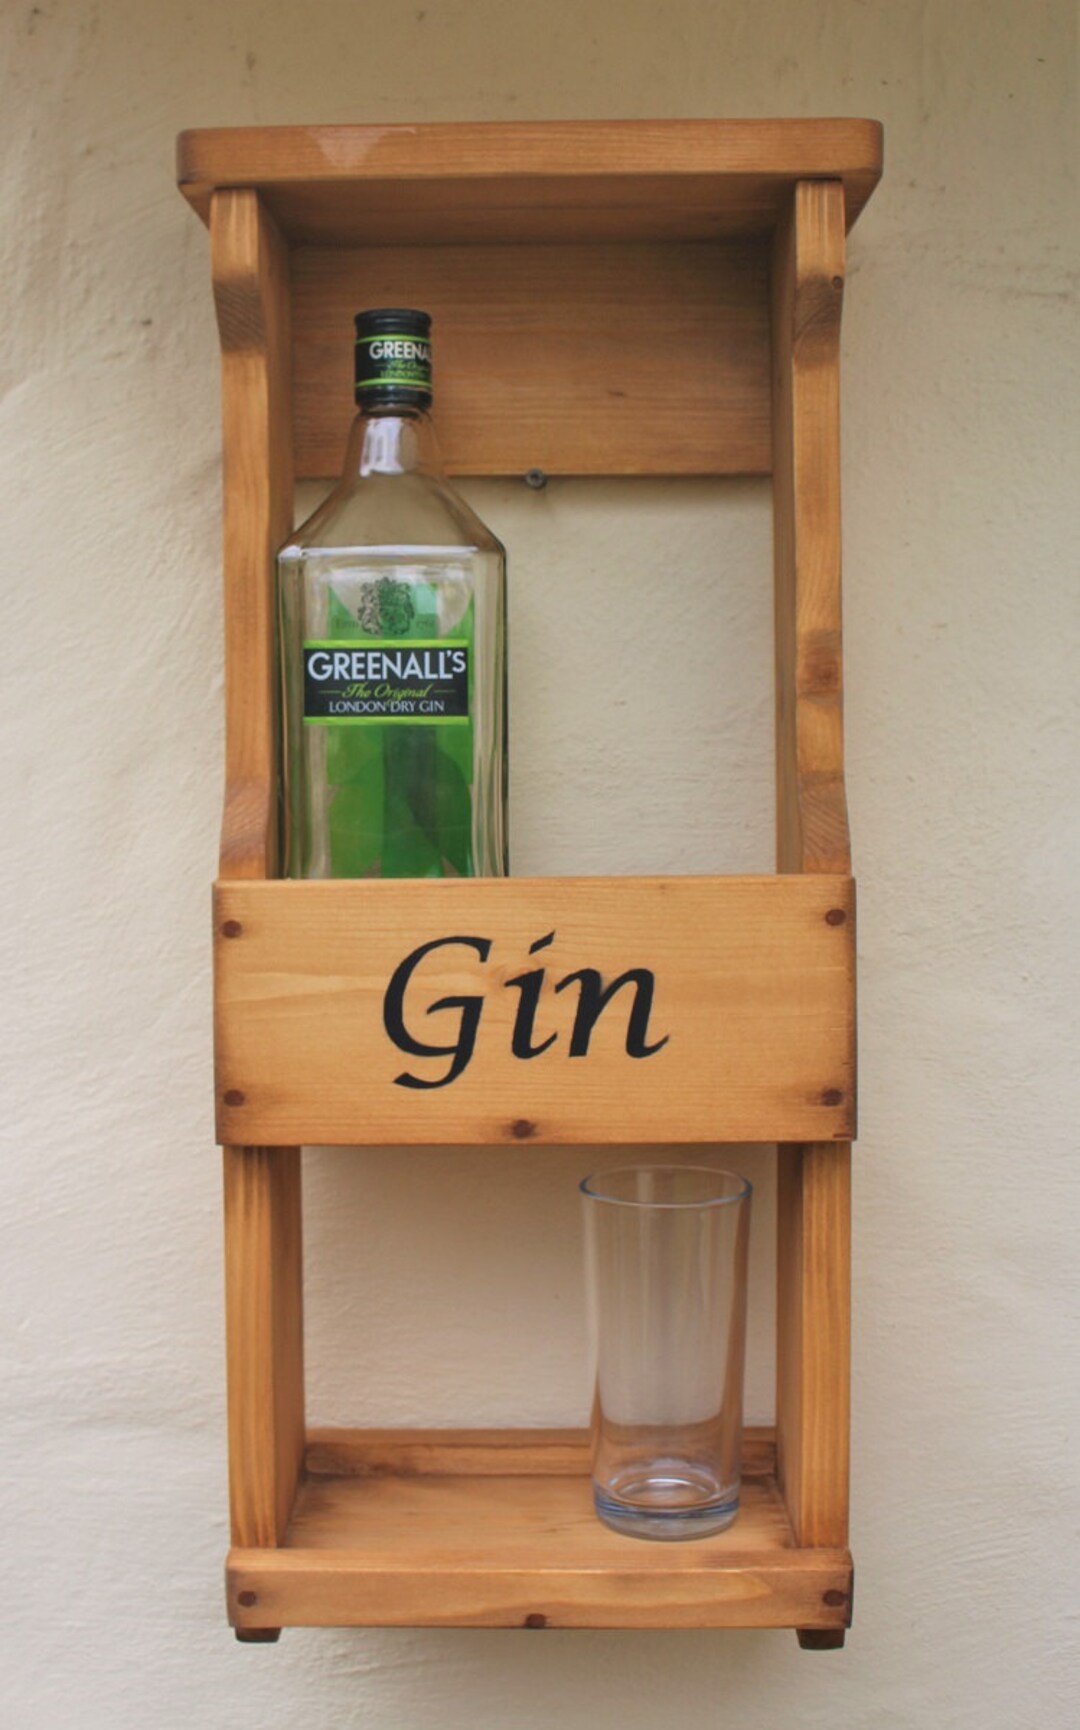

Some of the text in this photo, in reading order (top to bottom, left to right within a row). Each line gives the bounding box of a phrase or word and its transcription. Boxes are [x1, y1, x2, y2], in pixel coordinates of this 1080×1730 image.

[307, 650, 466, 681] GREENALL'S
[342, 682, 433, 702] The Original
[329, 701, 444, 713] LONDON DRY GIN
[383, 930, 669, 1090] Gin
